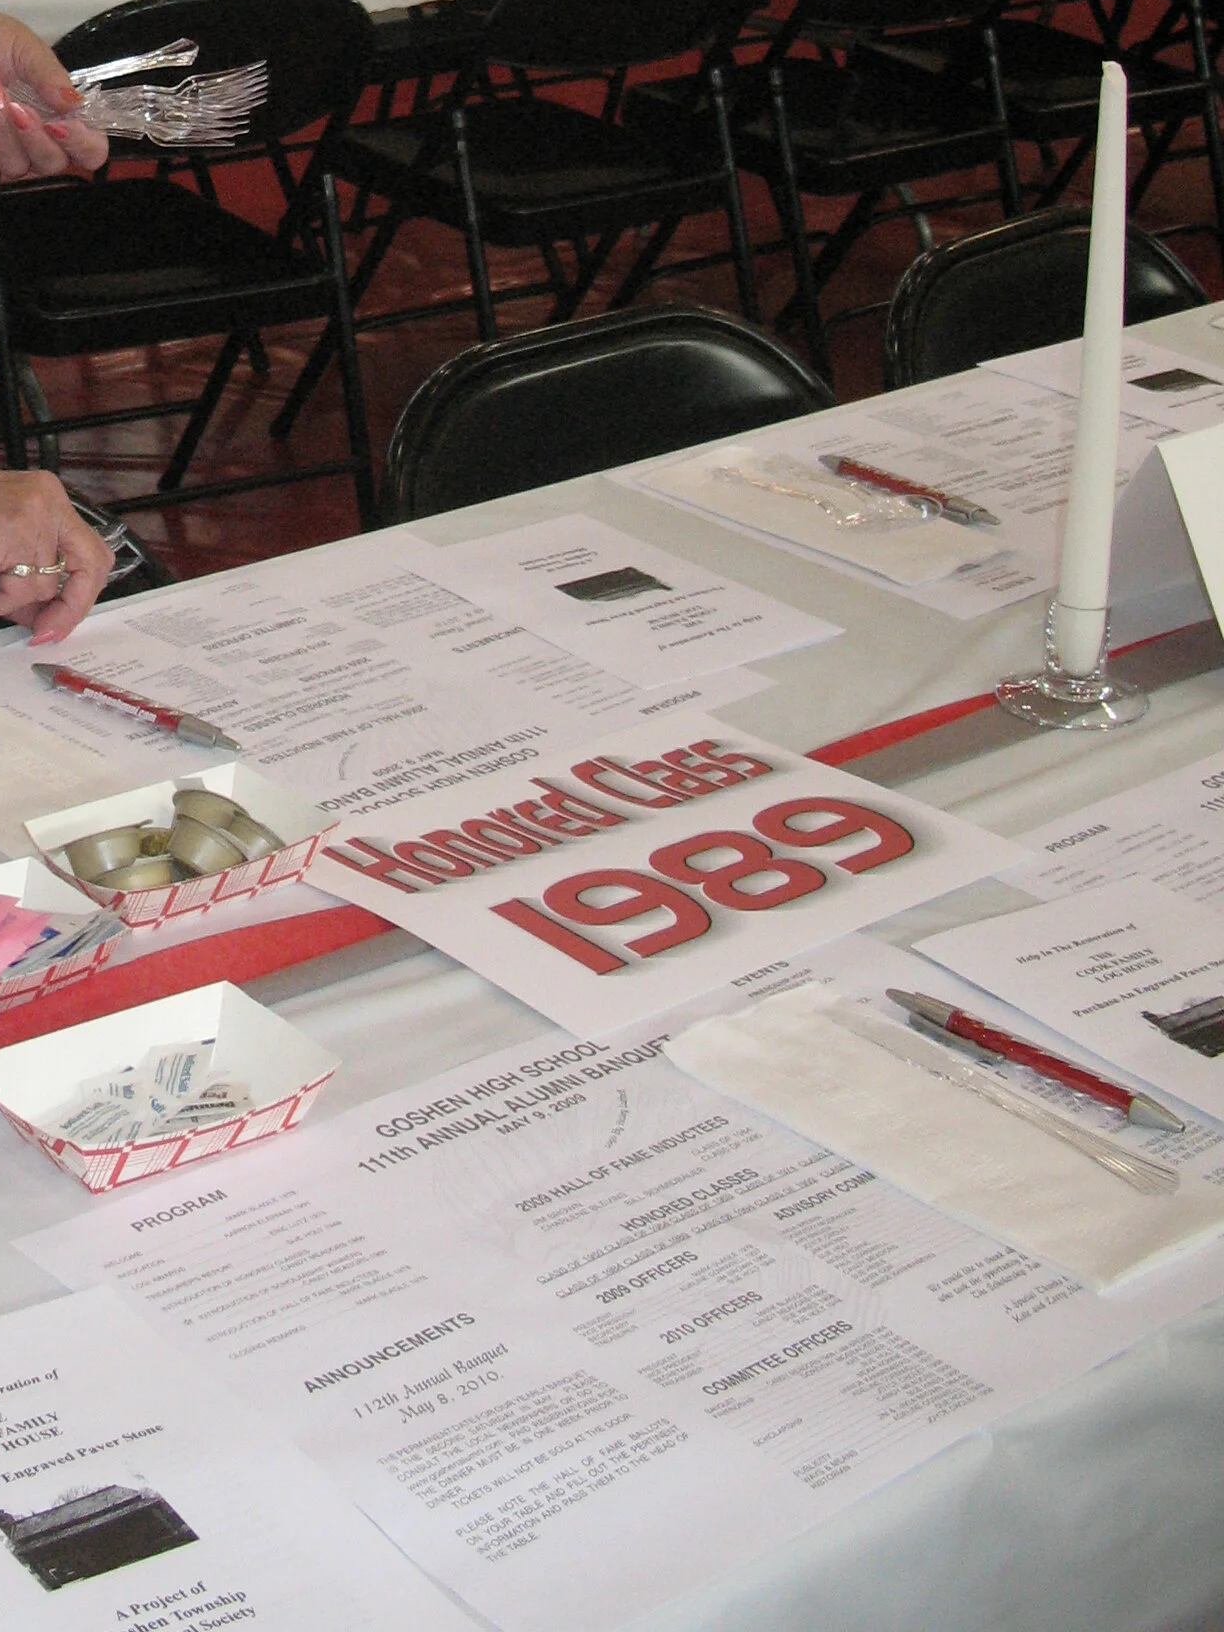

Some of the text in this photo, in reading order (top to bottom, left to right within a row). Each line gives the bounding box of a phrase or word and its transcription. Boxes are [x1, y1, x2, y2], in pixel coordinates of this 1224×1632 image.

[639, 689, 702, 715] PROGRAM
[376, 741, 505, 793] ANNUAL ALUMNI
[422, 747, 540, 792] GOSHEN HIGH
[322, 739, 774, 895] Honored Class
[1044, 823, 1111, 854] PROGRAM
[489, 796, 916, 976] 1989
[731, 959, 791, 988] EVENTS
[1016, 954, 1041, 965] Help
[1052, 944, 1072, 953] The
[1089, 951, 1116, 962] THE
[1095, 970, 1124, 984] LOG
[1110, 948, 1154, 968] FAMILY
[1072, 998, 1121, 1018] Purchase
[375, 1039, 610, 1139] GOSHEN HIGH SCHOOL
[358, 1144, 418, 1174] 111th
[416, 1108, 508, 1150] ANNUAL
[505, 1074, 586, 1115] ALUMNI
[495, 1093, 587, 1137] MAY 2009
[515, 1115, 729, 1214] 2009 HALL OF FAME INDUCTEES
[130, 1189, 228, 1232] PROGRAM
[620, 1168, 759, 1233] HONORED CLASSES
[773, 1186, 838, 1221] ADVISORY
[595, 1250, 698, 1305] 2009 OFFICERS
[659, 1322, 697, 1345] 2010
[693, 1290, 763, 1329] OFFICERS
[44, 1368, 60, 1383] of
[303, 1312, 475, 1394] ANNOUNCEMENTS
[701, 1352, 788, 1397] COMMITTEE
[784, 1319, 854, 1360] OFFICERS
[352, 1342, 510, 1420] 112th Annual Banquet
[400, 1370, 505, 1424] May 2010.
[0, 1452, 76, 1487] Engraved
[76, 1437, 128, 1458] Paver
[122, 1422, 165, 1444] Stone
[1, 1426, 64, 1453] HOUSE
[451, 1424, 606, 1510] TICKETS WILL NOT BE SOLD AT THE
[455, 1418, 671, 1538] PLEASE NOTE THE HALL OF FAME BALLOTS
[466, 1424, 680, 1547] ON YOUR TABLE AND FILL OUT THE PERTINENT
[477, 1432, 689, 1555] INFORMATION AND PASS THEM TO THE HEAD OF
[485, 1549, 508, 1564] THE
[115, 1580, 208, 1622] A Project of
[169, 1589, 248, 1622] Township
[199, 1606, 257, 1632] Society
